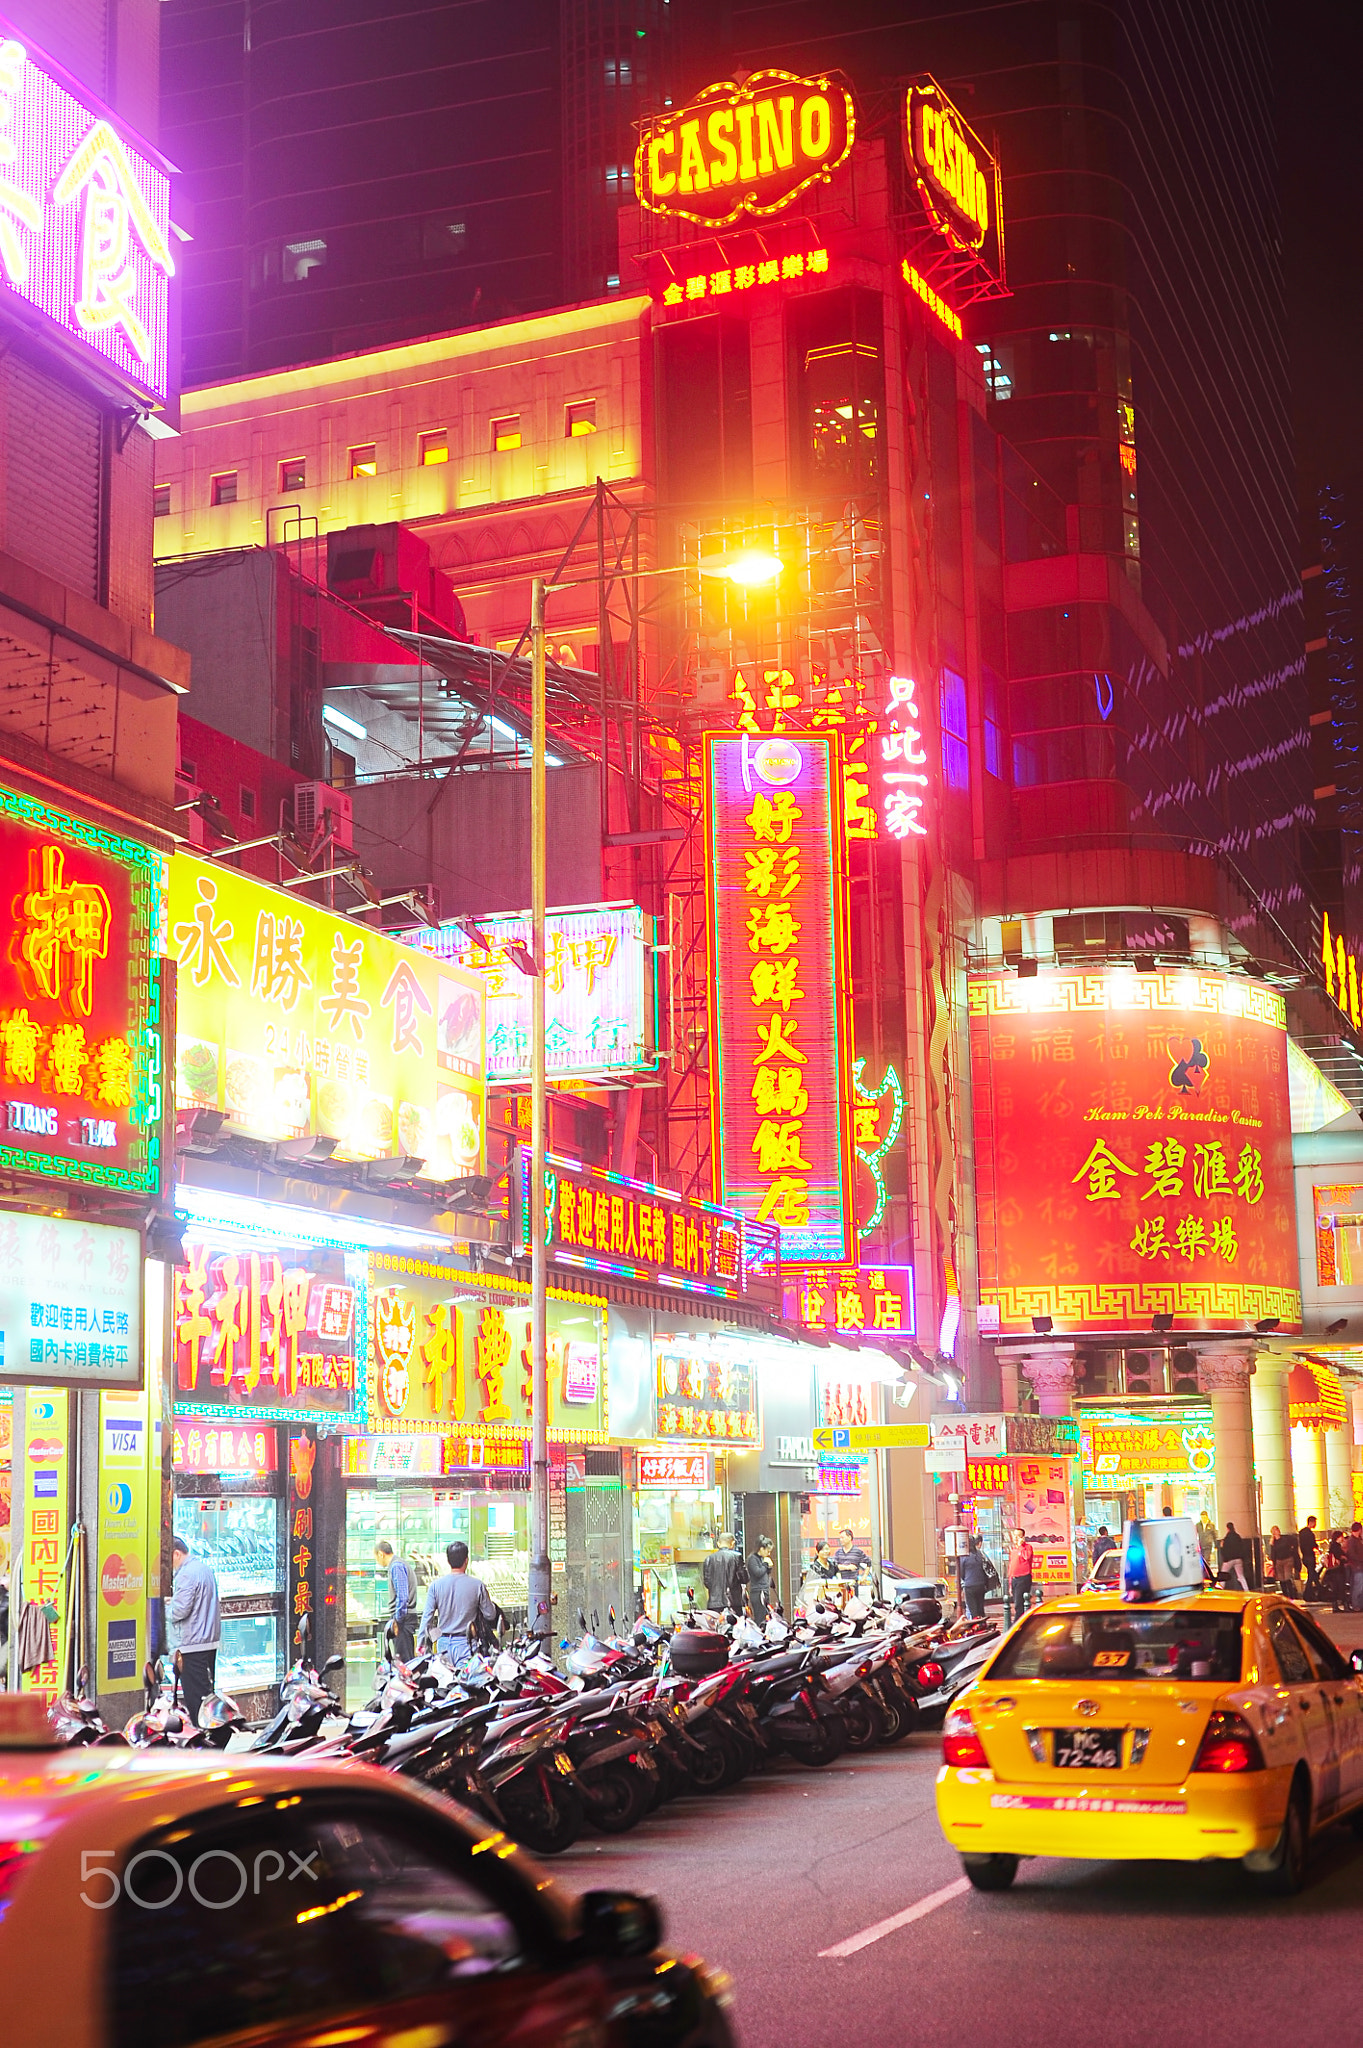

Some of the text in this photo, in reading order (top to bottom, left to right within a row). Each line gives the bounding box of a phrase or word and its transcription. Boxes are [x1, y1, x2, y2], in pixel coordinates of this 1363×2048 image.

[651, 95, 831, 196] CASINO
[922, 104, 988, 231] CASINO
[882, 676, 928, 840] 只此一家
[174, 877, 432, 1057] 永勝美食
[745, 791, 813, 1227] 好彩海鮮火鍋飯店
[1083, 1104, 1264, 1129] Kam Pek Paradise Casino
[559, 1178, 667, 1265] 歡迎使用人民幣
[672, 1212, 712, 1277] 國內卡
[1129, 1213, 1240, 1264] 娛樂場
[30, 1302, 129, 1335] 歡迎使用人民幣
[30, 1338, 129, 1370] 國內卡消費特平
[299, 1353, 354, 1389] 有限公司
[28, 1447, 65, 1456] MasterCard
[112, 1434, 137, 1451] VISA
[836, 1431, 846, 1447] P
[102, 1573, 144, 1591] MasterCard
[293, 1506, 314, 1646] 刷卡最
[30, 1510, 59, 1708] 國內卡特
[109, 1640, 136, 1650] AMERICAN
[113, 1651, 137, 1662] EXPRESS
[1100, 1654, 1126, 1665] 37
